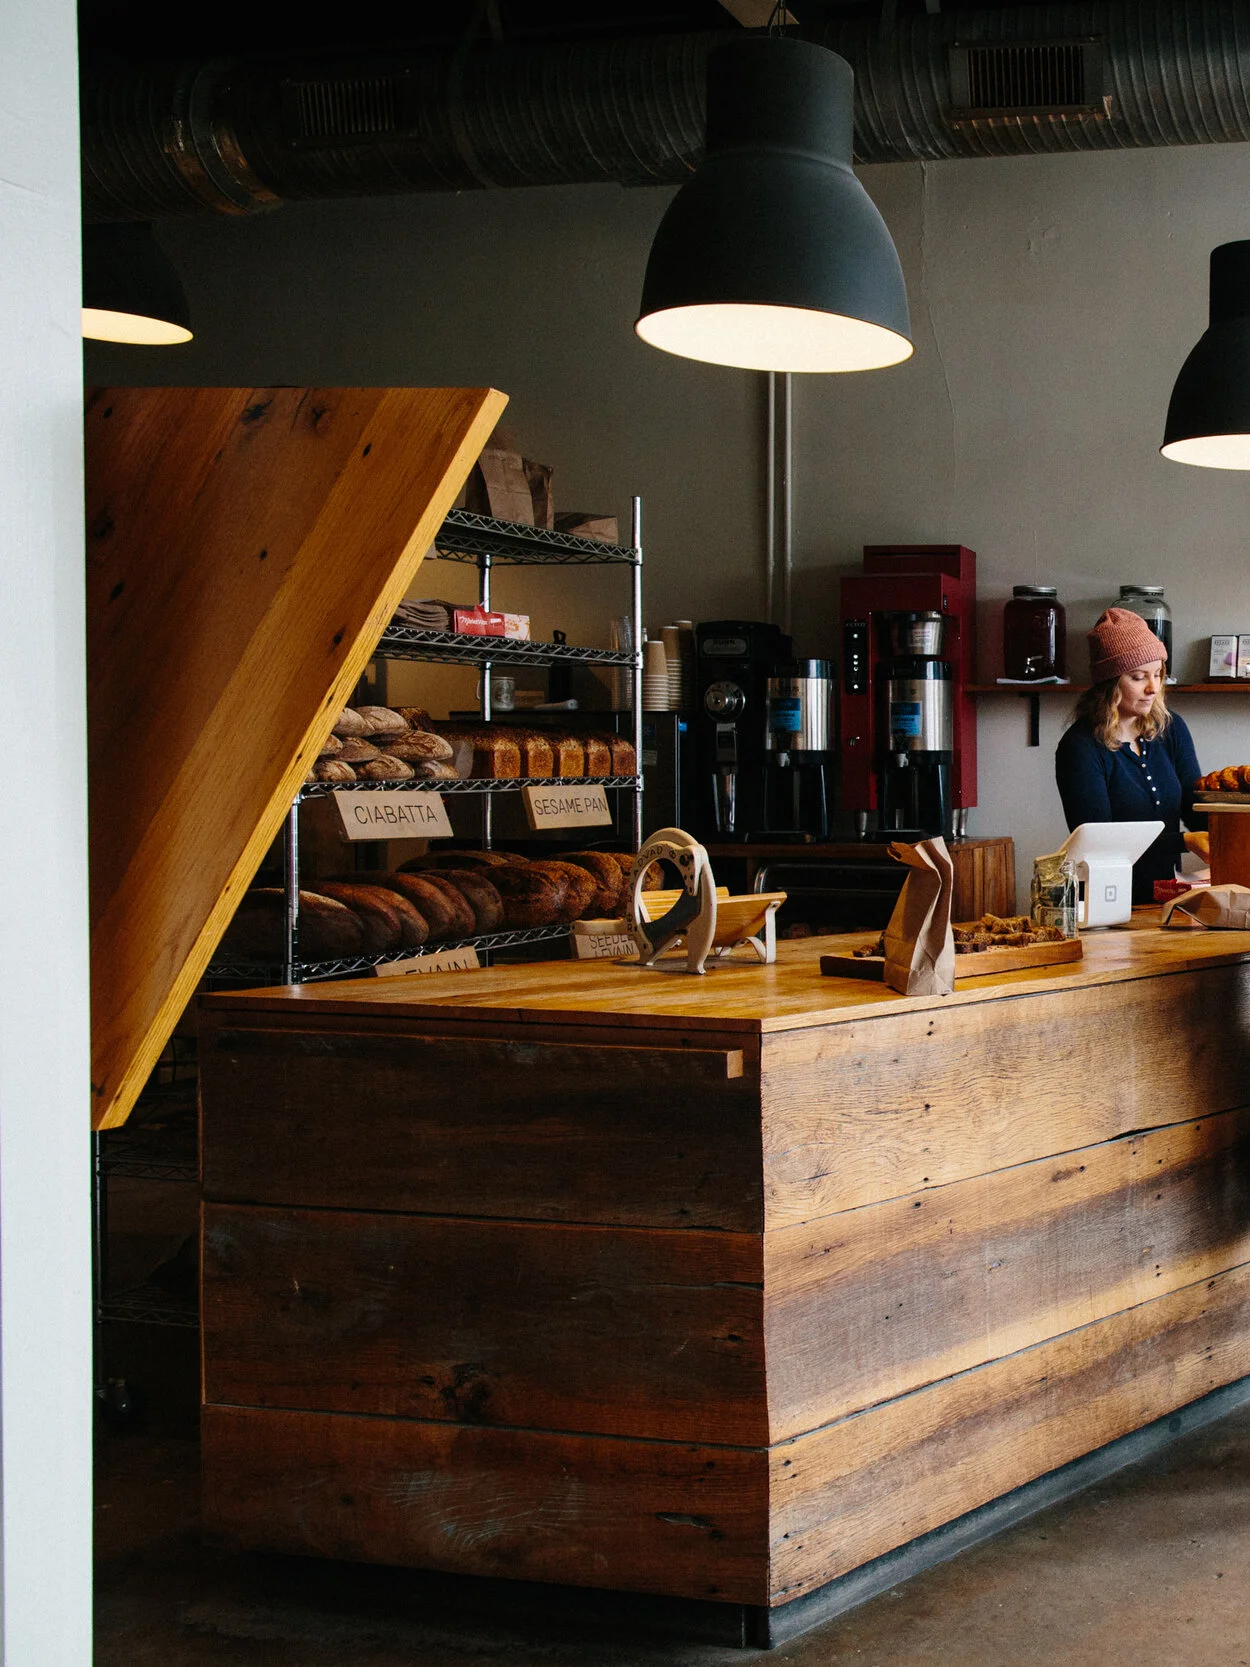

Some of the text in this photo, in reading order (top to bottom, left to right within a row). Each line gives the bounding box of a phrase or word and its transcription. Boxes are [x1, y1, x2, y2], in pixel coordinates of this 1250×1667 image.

[355, 805, 437, 824] CIABATTA
[535, 796, 607, 816] SESAME PAN
